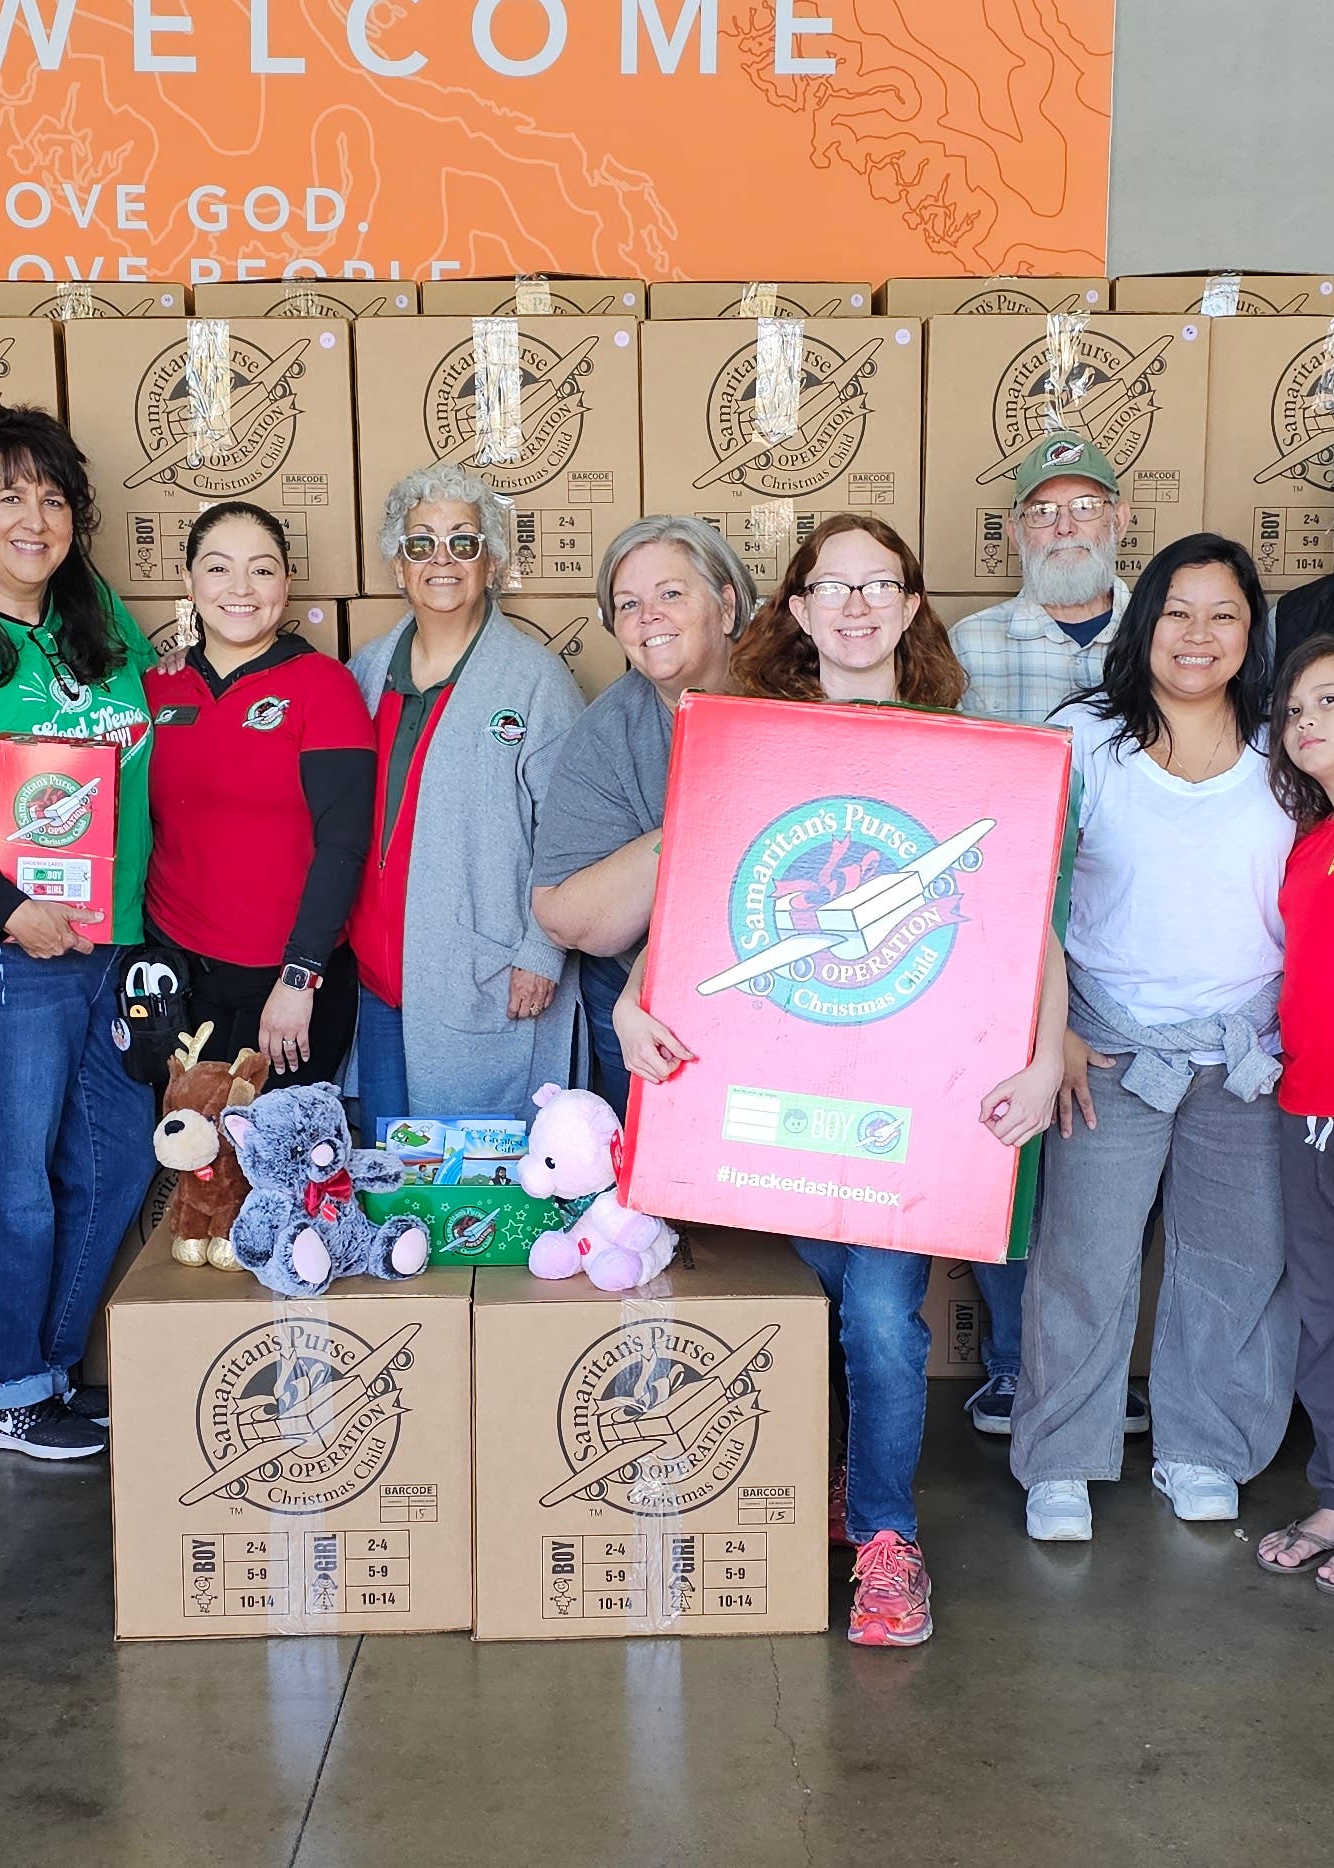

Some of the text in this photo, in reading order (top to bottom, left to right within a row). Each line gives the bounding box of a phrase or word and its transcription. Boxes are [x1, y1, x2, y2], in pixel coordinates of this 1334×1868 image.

[186, 184, 369, 233] GOD.
[209, 405, 285, 467] OPERATION
[778, 405, 855, 467] OPERATION
[1114, 431, 1142, 466] Child
[192, 434, 286, 491] Christmas Child
[480, 432, 573, 489] Christmas Child
[761, 433, 855, 490] Christmas Child
[285, 475, 324, 483] BARCODE
[571, 472, 610, 480] BARCODE
[852, 473, 891, 482] BARCODE
[1137, 471, 1176, 480] BARCODE
[874, 492, 887, 502] 15
[558, 516, 576, 527] 2-4
[983, 511, 1003, 541] BOY
[1261, 511, 1280, 539] BOY
[1303, 514, 1320, 525] 2-4
[136, 516, 155, 545] BOY
[517, 511, 536, 544] GIRL
[559, 538, 576, 549] 5-9
[1120, 537, 1138, 548] 5-9
[1302, 536, 1319, 547] 5-9
[554, 561, 582, 572] 10-14
[1295, 559, 1324, 569] 10-14
[18, 774, 77, 826] Samaritan's Purse
[47, 805, 87, 836] OPERATION
[71, 818, 87, 838] Child
[46, 870, 63, 880] BOY
[740, 802, 919, 950] Samaritan's Purse
[45, 884, 64, 896] GIRL
[821, 906, 942, 984] OPERATION
[793, 944, 939, 1017] Christmas Child
[810, 1107, 855, 1142] BOY
[716, 1165, 900, 1207] #ipackedashoebox
[955, 1303, 974, 1331] BOY
[213, 1325, 356, 1461] Samaritan's Purse
[573, 1325, 716, 1463] Samaritan's Purse
[289, 1403, 386, 1478] OPERATION
[648, 1403, 745, 1478] OPERATION
[712, 1439, 745, 1482] Child
[267, 1437, 387, 1506] Christmas Child
[384, 1486, 433, 1496] BARCODE
[741, 1487, 791, 1498] BARCODE
[229, 1507, 244, 1516] TM
[414, 1507, 426, 1519] 15
[588, 1508, 603, 1518] TM
[769, 1510, 785, 1521] 15
[246, 1541, 267, 1554] 2-4
[367, 1538, 388, 1551] 2-4
[605, 1543, 626, 1556] 2-4
[725, 1540, 745, 1553] 2-4
[192, 1539, 216, 1573] BOY
[314, 1533, 337, 1572] GIRL
[551, 1540, 575, 1575] BOY
[672, 1535, 695, 1574] GIRL
[246, 1567, 267, 1580] 5-9
[368, 1565, 389, 1577] 5-9
[605, 1570, 626, 1583] 5-9
[725, 1567, 746, 1580] 5-9
[239, 1594, 275, 1608] 10-14
[360, 1592, 396, 1605] 10-14
[598, 1597, 633, 1610] 10-14
[717, 1595, 753, 1608] 10-14
